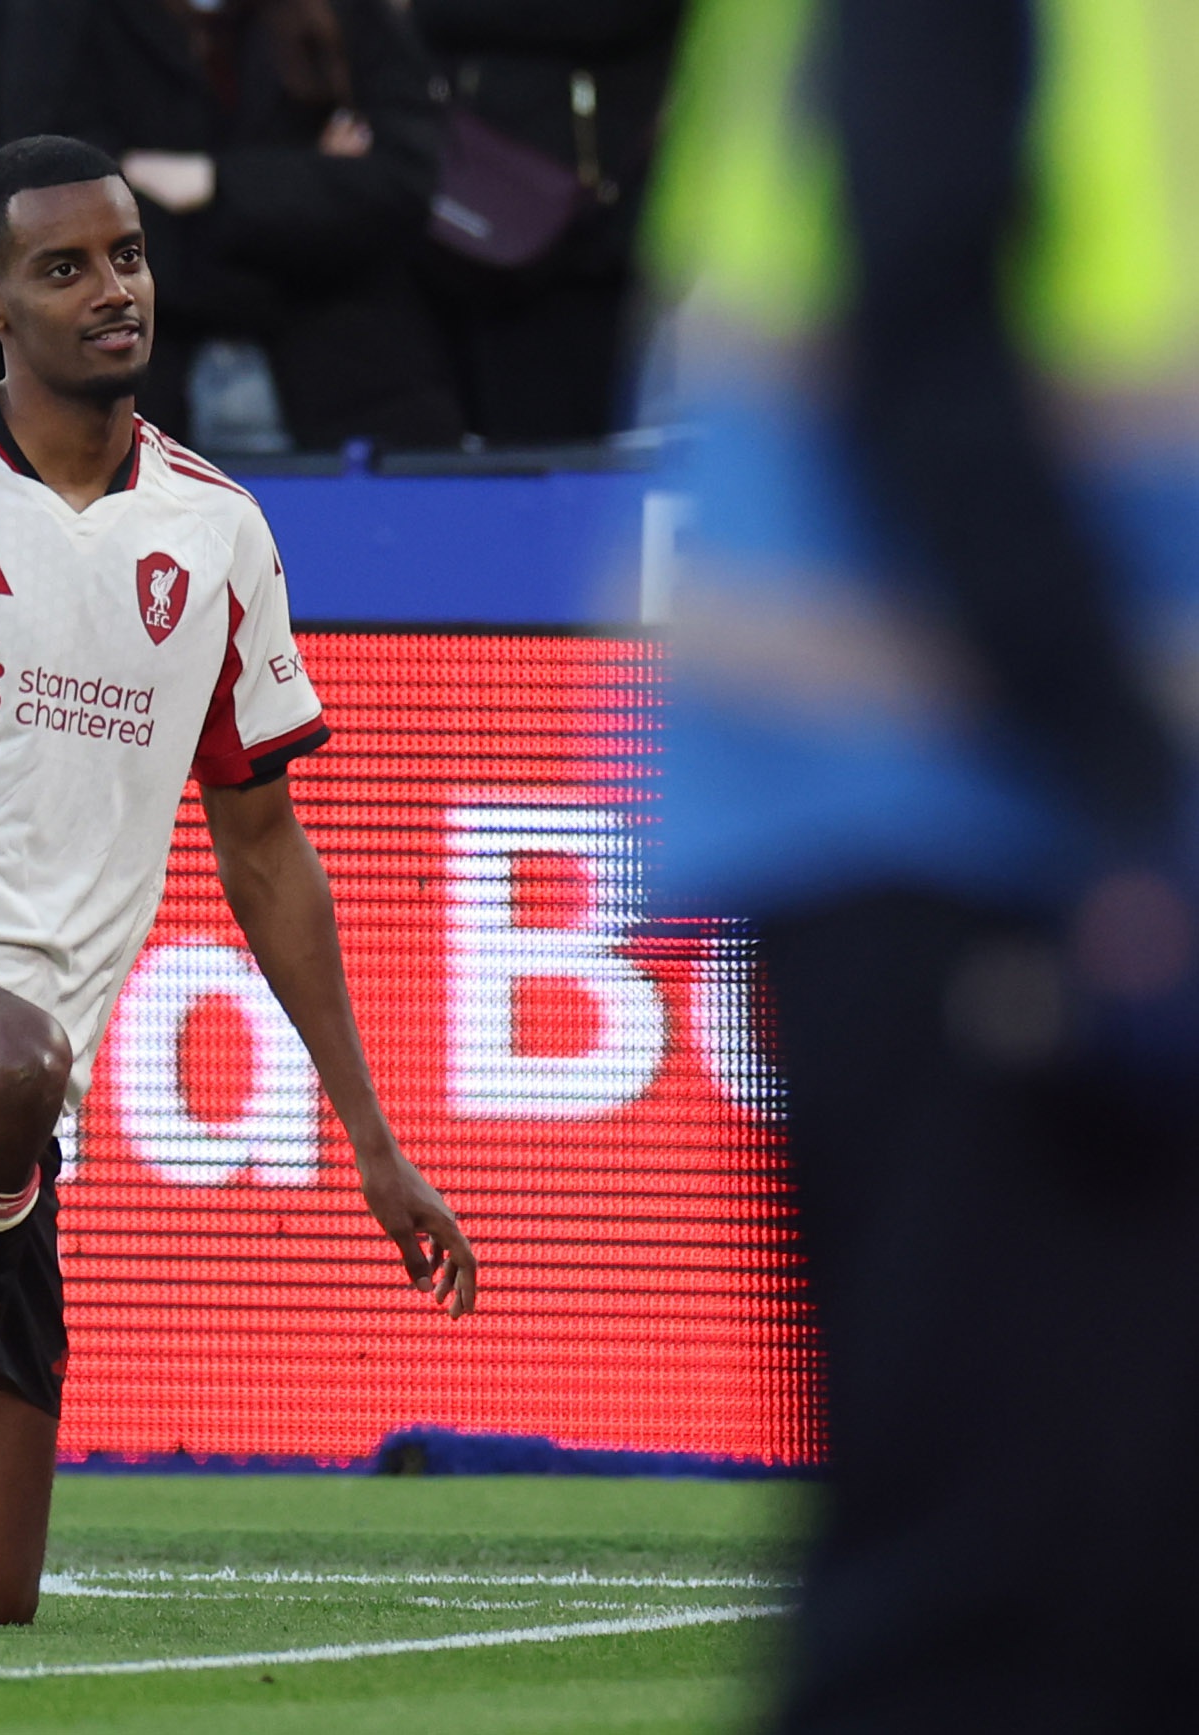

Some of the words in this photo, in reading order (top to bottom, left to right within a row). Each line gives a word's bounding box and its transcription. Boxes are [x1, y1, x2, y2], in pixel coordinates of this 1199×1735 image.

[18, 666, 155, 715] standard
[268, 652, 303, 684] Ex
[15, 698, 155, 747] chartered
